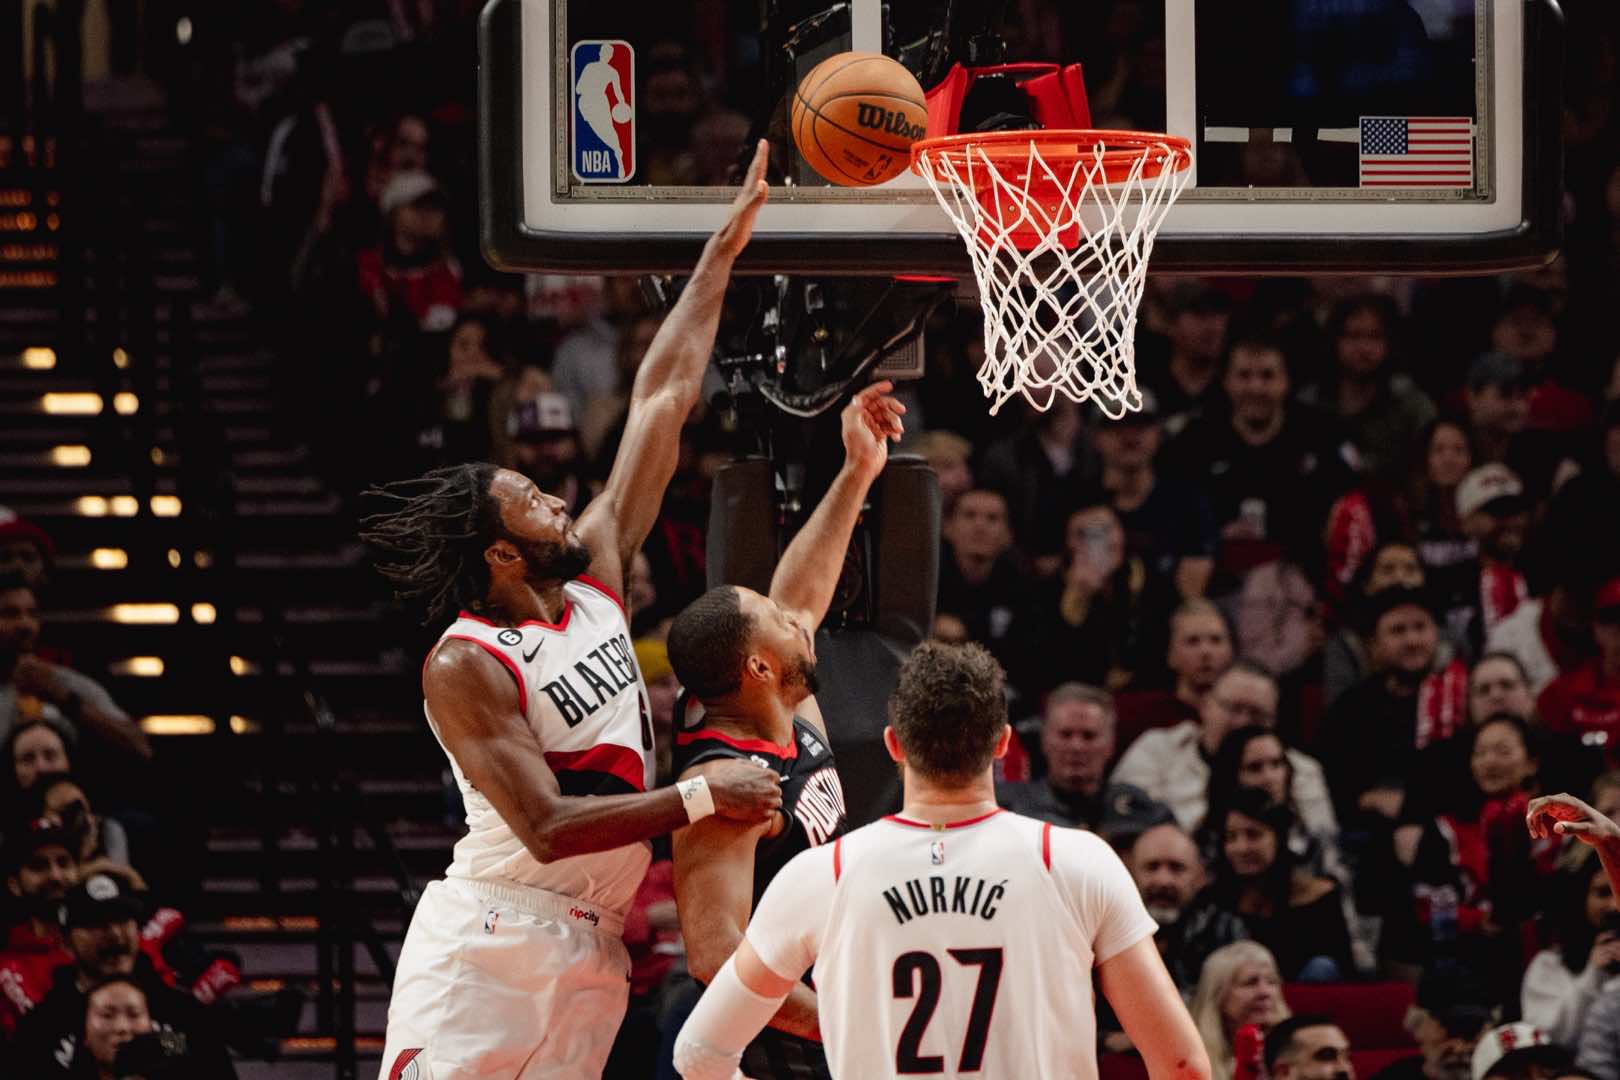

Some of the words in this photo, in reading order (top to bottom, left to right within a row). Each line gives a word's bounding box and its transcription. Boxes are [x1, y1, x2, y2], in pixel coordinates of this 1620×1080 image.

[858, 102, 926, 139] Wilson
[582, 150, 612, 173] NBA
[882, 876, 1008, 925] NURKIĆ
[892, 947, 1004, 1075] 27
